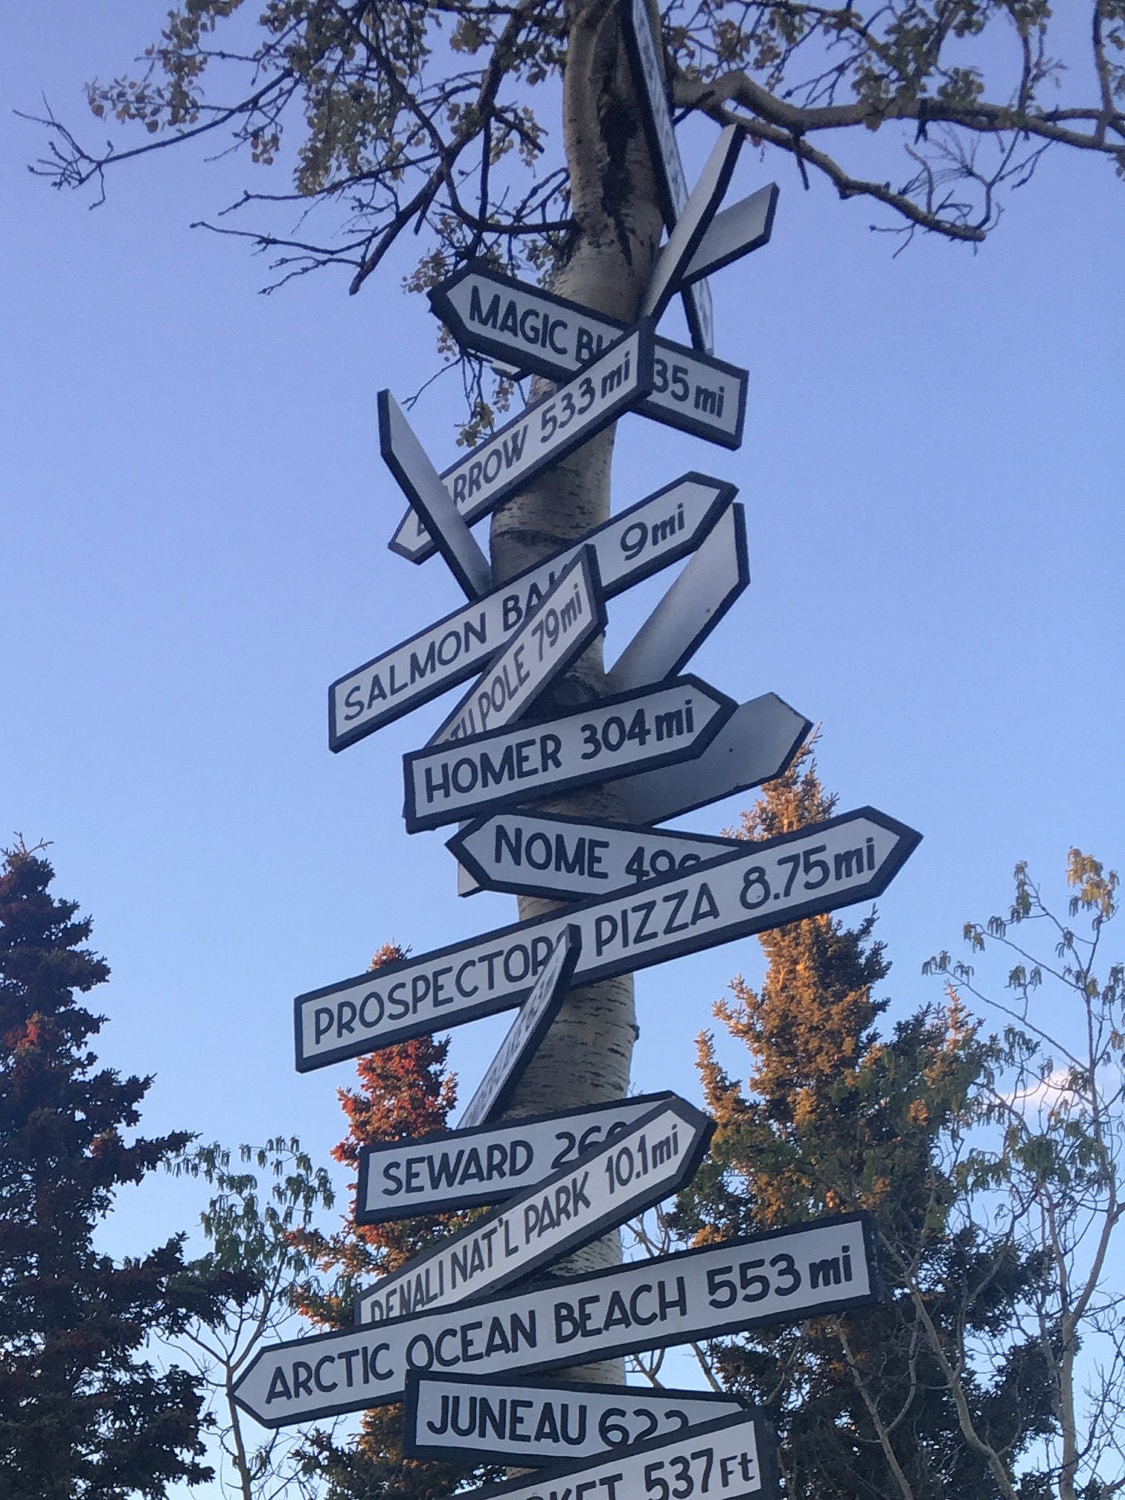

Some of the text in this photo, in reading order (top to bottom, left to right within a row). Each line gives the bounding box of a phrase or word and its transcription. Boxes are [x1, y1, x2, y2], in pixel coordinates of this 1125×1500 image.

[469, 285, 567, 355] MAGIC
[344, 613, 486, 722] SALMON
[502, 564, 569, 632] BA
[478, 643, 531, 732] POLE
[425, 735, 563, 804] HOMER
[494, 824, 610, 880] NOME
[314, 932, 566, 1045] PROSPECTOR
[595, 882, 720, 958] PIZZA
[382, 1139, 534, 1196] SEWARD
[370, 1260, 444, 1323] DENALI
[450, 1214, 519, 1290] NAT'L
[525, 1171, 592, 1244] PARK
[266, 1345, 394, 1405] ARCTIC
[405, 1314, 538, 1374] OCEAN
[555, 1283, 688, 1344] BEACH
[427, 1395, 587, 1445] JUNEAU
